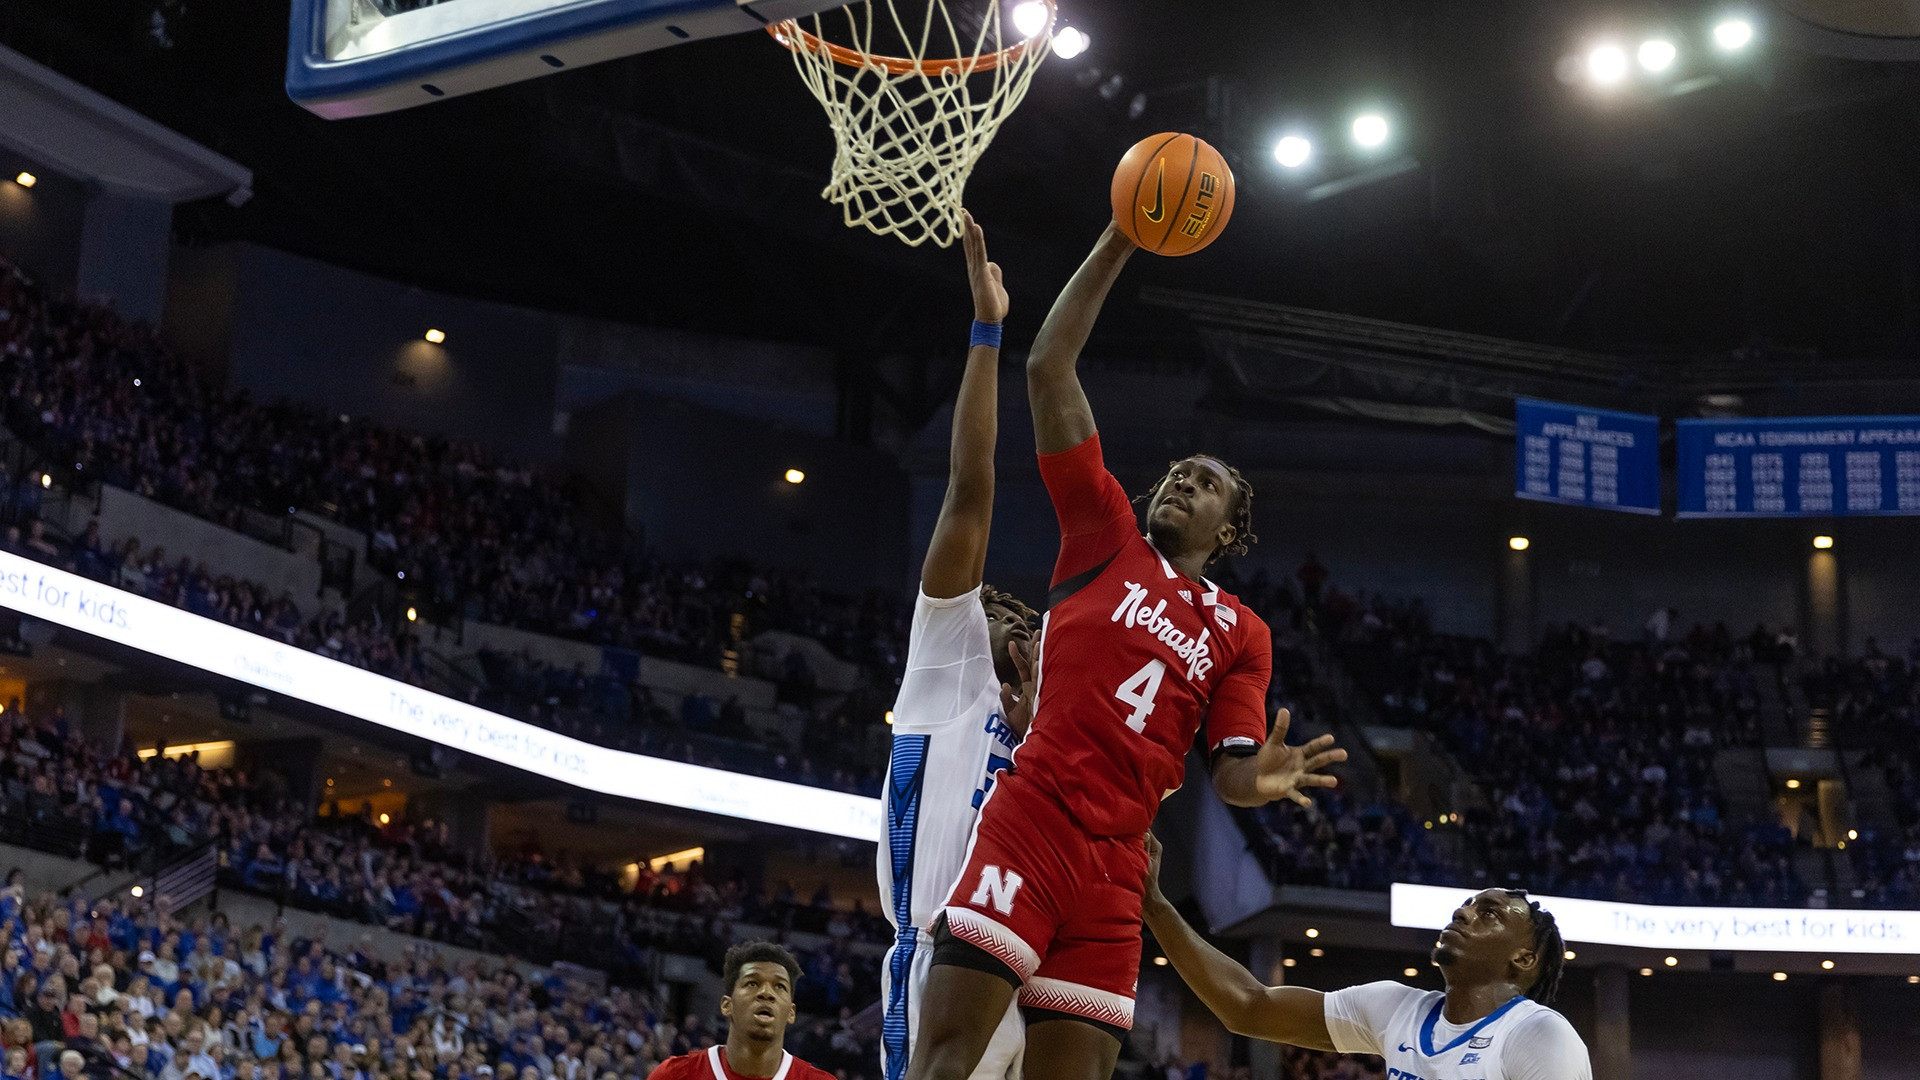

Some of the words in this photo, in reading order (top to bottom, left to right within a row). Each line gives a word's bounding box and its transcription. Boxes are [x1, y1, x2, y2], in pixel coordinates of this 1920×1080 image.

[1180, 171, 1215, 237] ELITE
[1714, 431, 1756, 447] NCAA
[1759, 430, 1855, 446] TOURNAMENT
[38, 576, 70, 608] for
[1111, 580, 1214, 681] Nebraska
[1114, 658, 1167, 735] 4
[969, 865, 1023, 917] N
[1613, 911, 1656, 935] The
[1665, 919, 1723, 942] very
[1733, 915, 1791, 938] best
[1802, 916, 1834, 938] for
